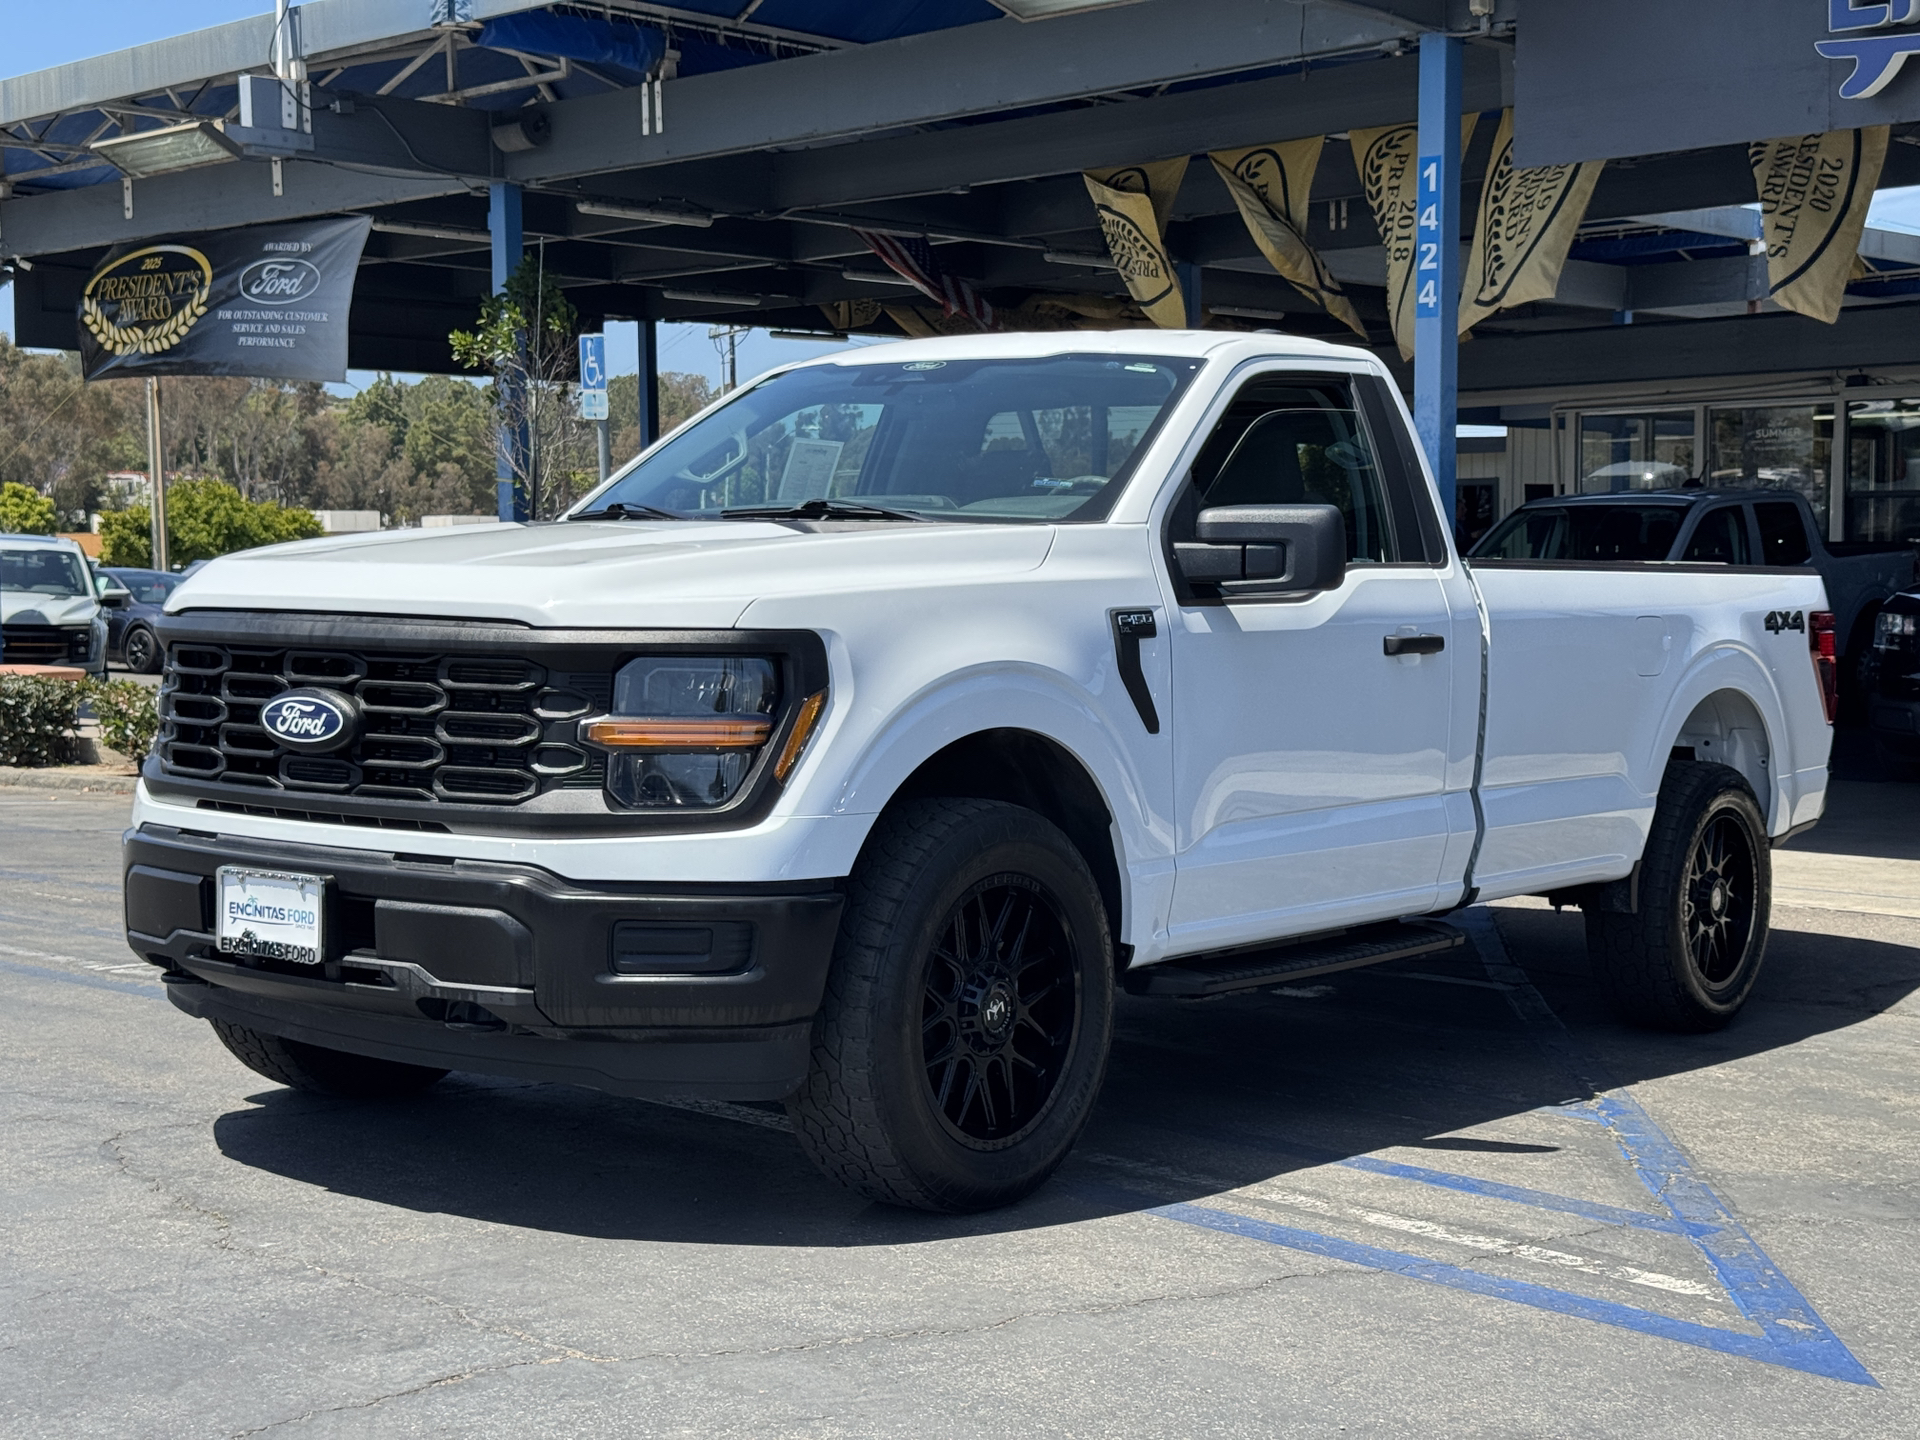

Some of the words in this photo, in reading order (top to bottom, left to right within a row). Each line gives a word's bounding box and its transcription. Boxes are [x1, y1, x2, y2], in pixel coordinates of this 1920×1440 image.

[1760, 142, 1797, 215] AWARD
[1809, 158, 1844, 213] 2020
[1505, 169, 1534, 241] WARD
[1767, 133, 1823, 258] RESIDENT'S
[1393, 199, 1417, 262] 2018
[1418, 162, 1439, 309] 1424
[262, 242, 300, 252] AWARDED
[301, 242, 313, 252] BY
[140, 256, 164, 271] 2025
[96, 270, 202, 301] PRESIDENT'S
[250, 264, 307, 295] Ford
[117, 296, 172, 322] AWARD
[217, 310, 233, 320] FOR
[233, 310, 284, 321] OUTSTANDING
[285, 310, 329, 322] CUSTOMER
[231, 323, 264, 333] SERVICE
[264, 324, 280, 334] AND
[281, 324, 306, 335] SALES
[237, 336, 296, 348] PERFORMANCE
[1755, 427, 1801, 439] SUMMER
[276, 701, 328, 736] Ford
[229, 901, 286, 921] ENCINITAS
[287, 909, 315, 925] FORD
[285, 944, 316, 963] FORD
